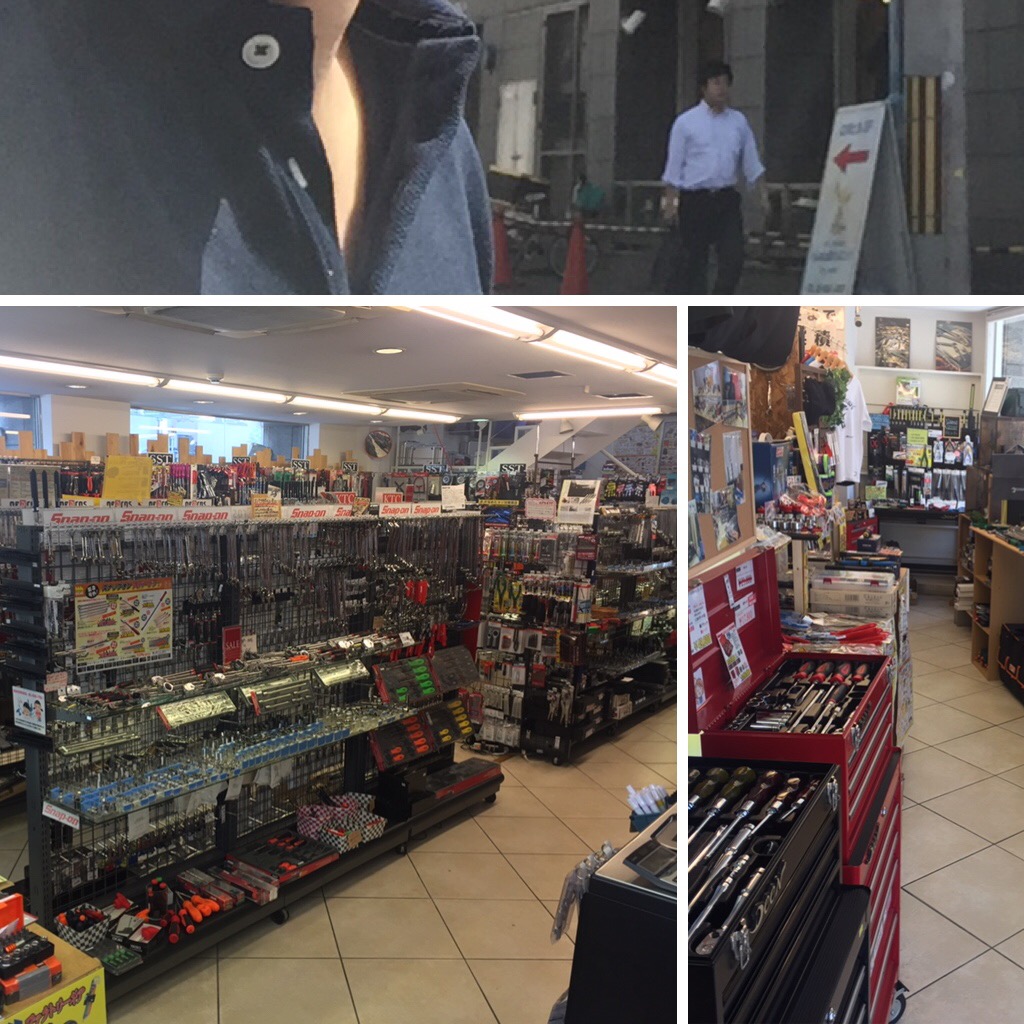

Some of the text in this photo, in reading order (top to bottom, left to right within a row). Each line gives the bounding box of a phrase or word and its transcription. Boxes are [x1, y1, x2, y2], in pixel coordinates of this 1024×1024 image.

[292, 460, 310, 470] SST
[343, 462, 358, 472] SST
[501, 464, 525, 473] SST
[383, 494, 401, 503] KTC
[290, 508, 326, 518] Snap-on
[381, 505, 410, 515] Snap-on
[413, 505, 440, 515] Snap-on
[51, 513, 110, 524] Snap-on
[120, 510, 173, 523] Snap-on
[182, 510, 228, 521] Snap-on
[225, 640, 240, 650] SALE
[44, 804, 79, 826] Snap-on
